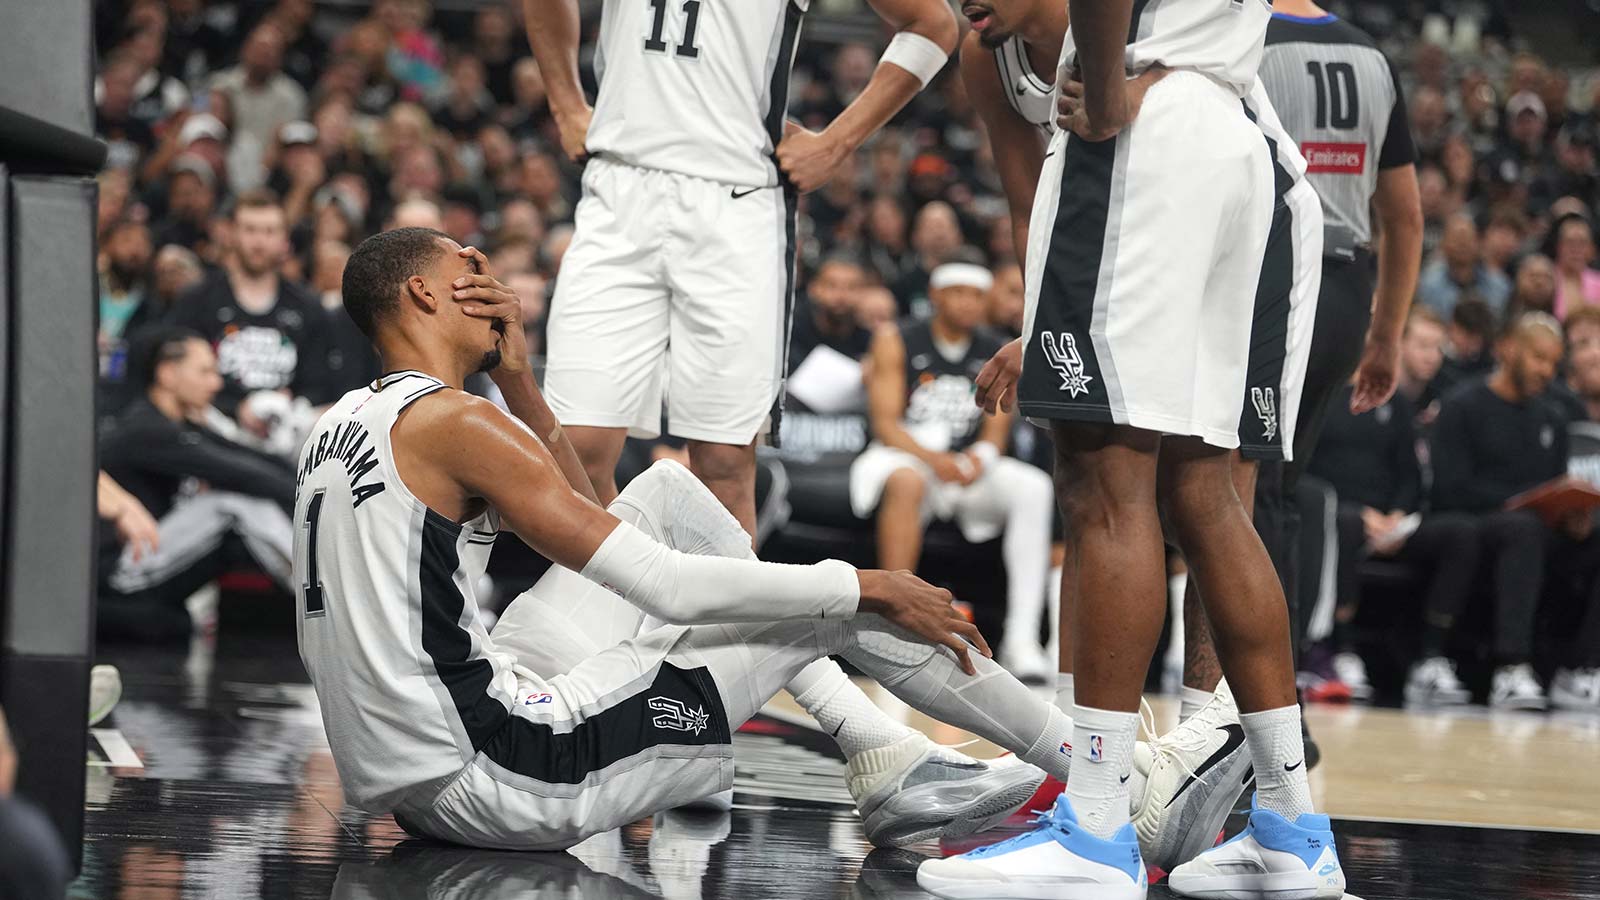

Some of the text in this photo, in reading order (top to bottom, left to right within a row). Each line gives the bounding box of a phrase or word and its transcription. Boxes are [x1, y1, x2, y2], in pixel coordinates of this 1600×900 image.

[644, 0, 701, 58] 11
[1307, 61, 1359, 130] 10
[1305, 148, 1360, 168] Emirates
[295, 421, 386, 509] MBANYAMA
[304, 489, 326, 616] 1
